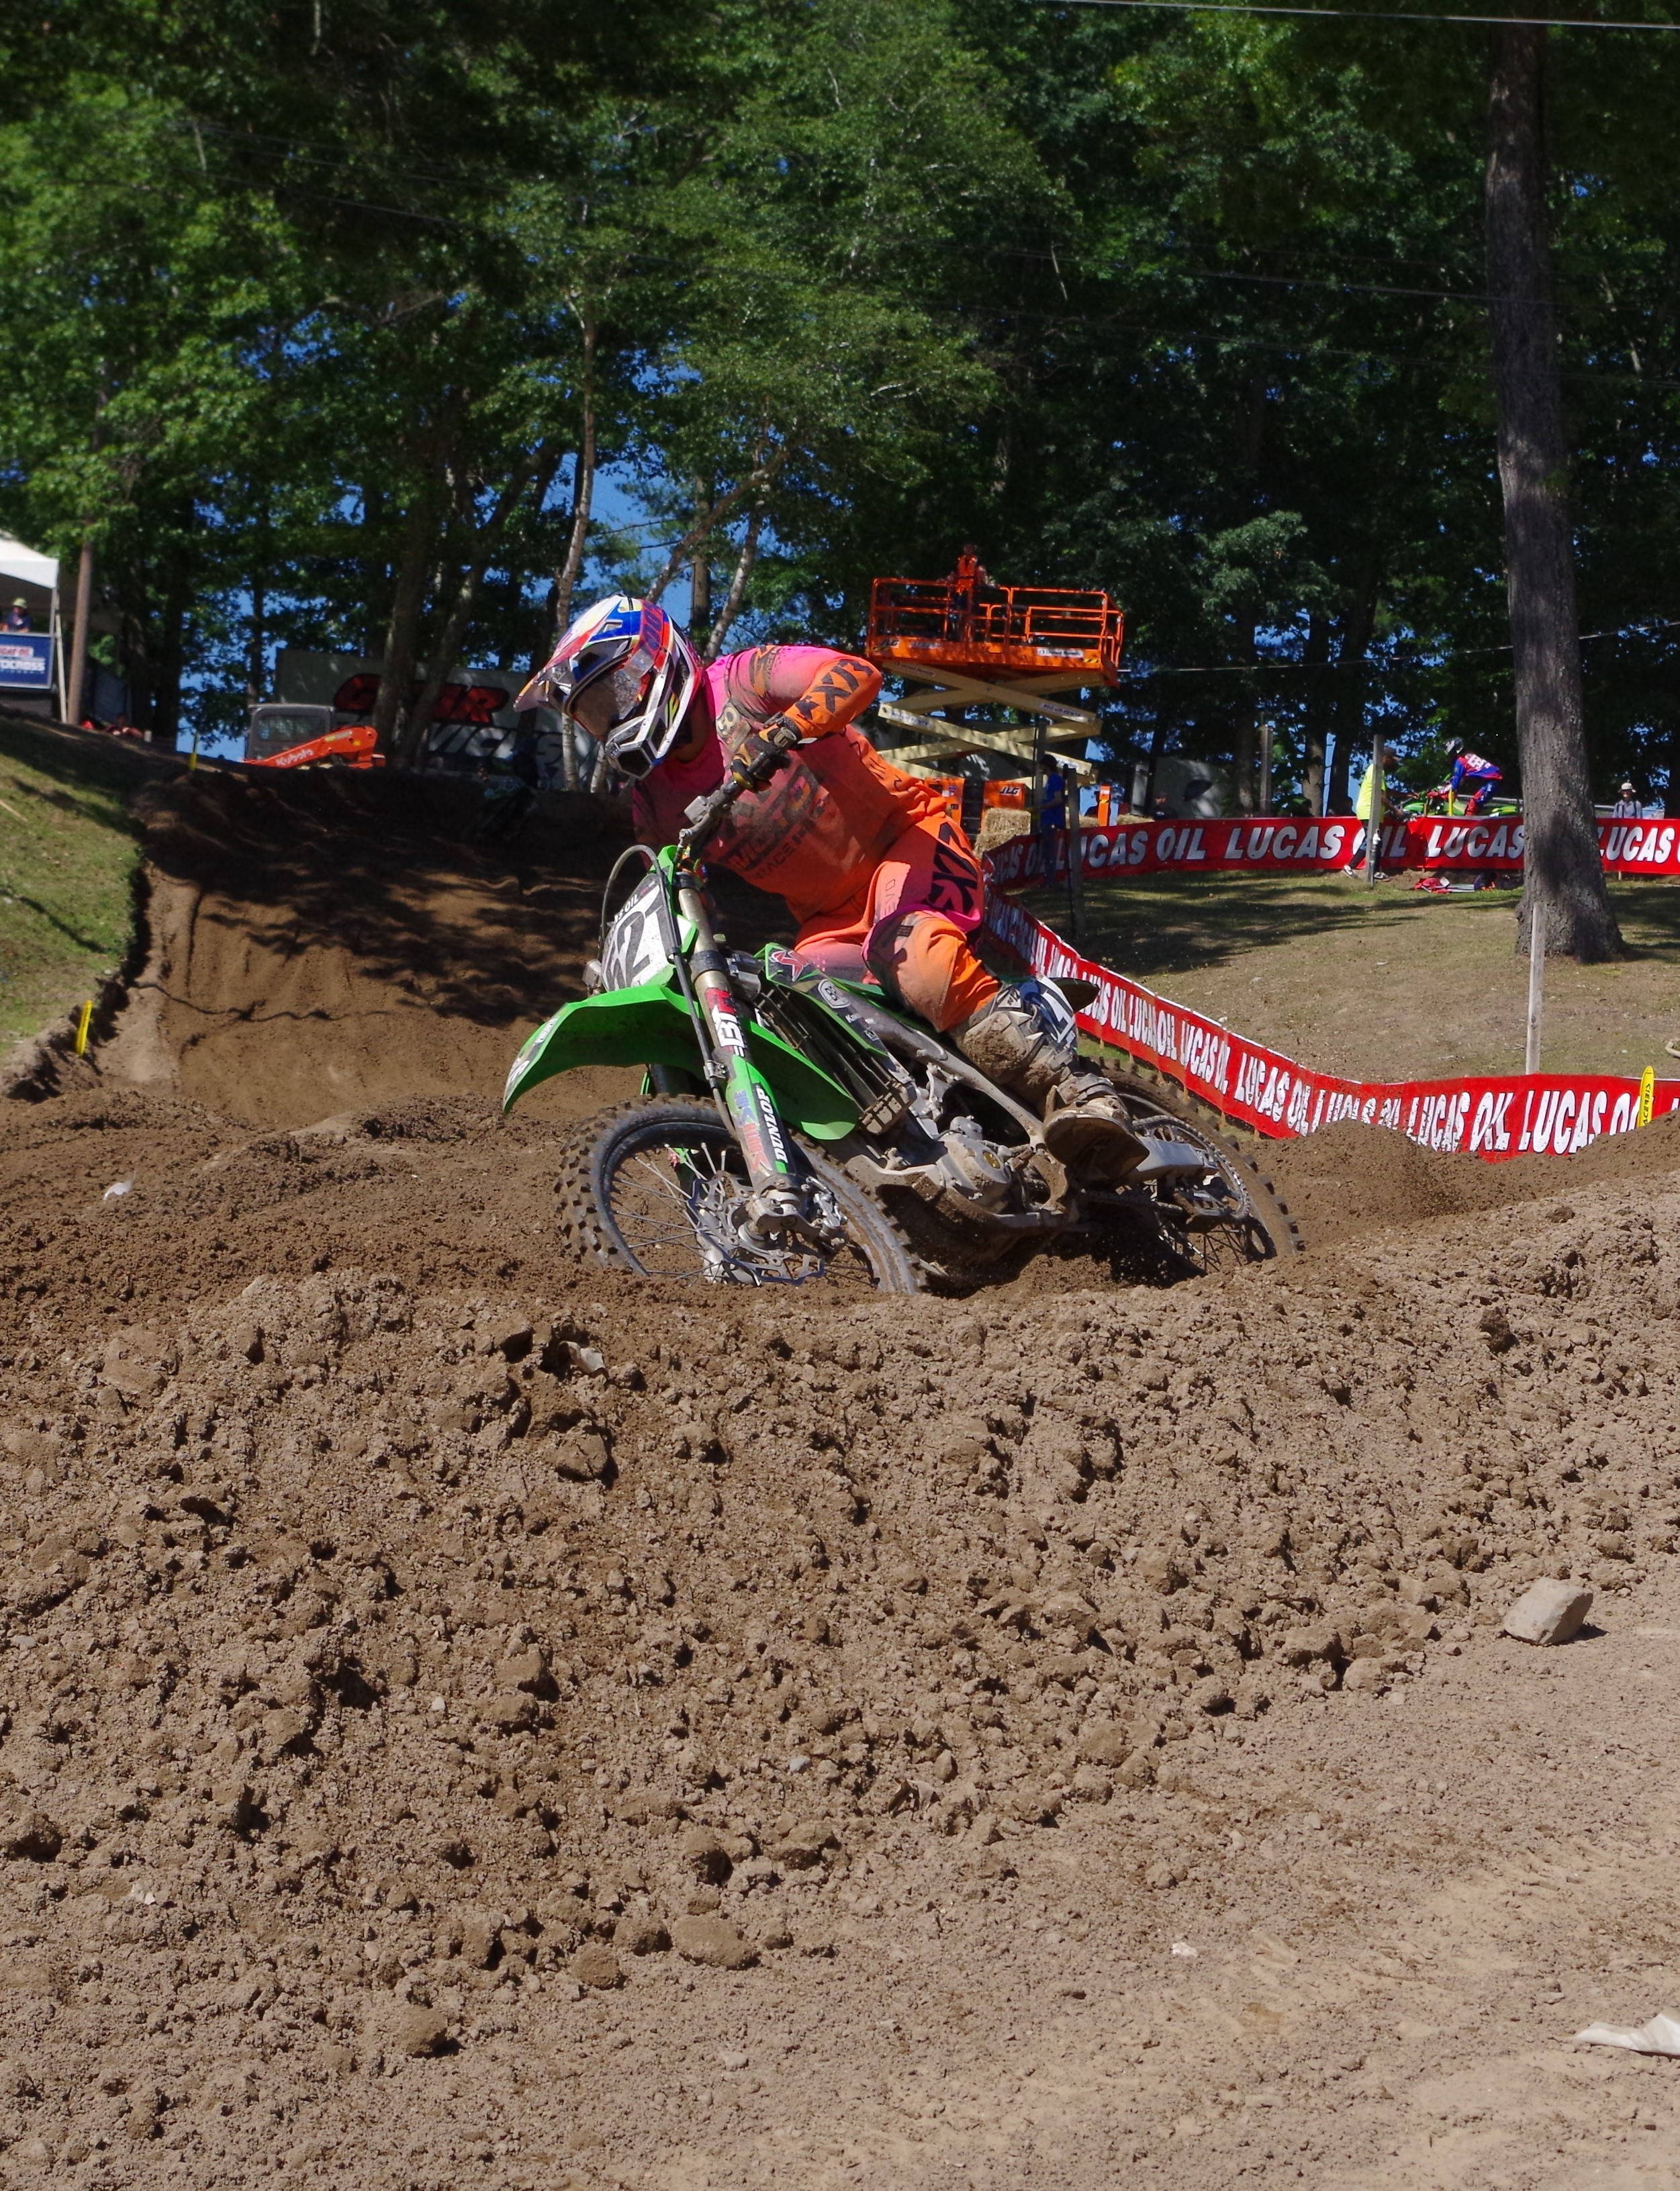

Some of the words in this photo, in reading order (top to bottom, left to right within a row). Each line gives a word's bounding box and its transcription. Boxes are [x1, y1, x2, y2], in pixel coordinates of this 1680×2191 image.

[276, 749, 314, 766] Kubota
[998, 786, 1020, 795] JLG
[1055, 830, 1149, 871] LCAS
[1156, 827, 1206, 862] OIL
[1223, 825, 1346, 860] LUCAS
[1234, 1052, 1291, 1123] LUCAS
[756, 1085, 788, 1164] DUNLOP
[1518, 1089, 1608, 1155] LUCAS
